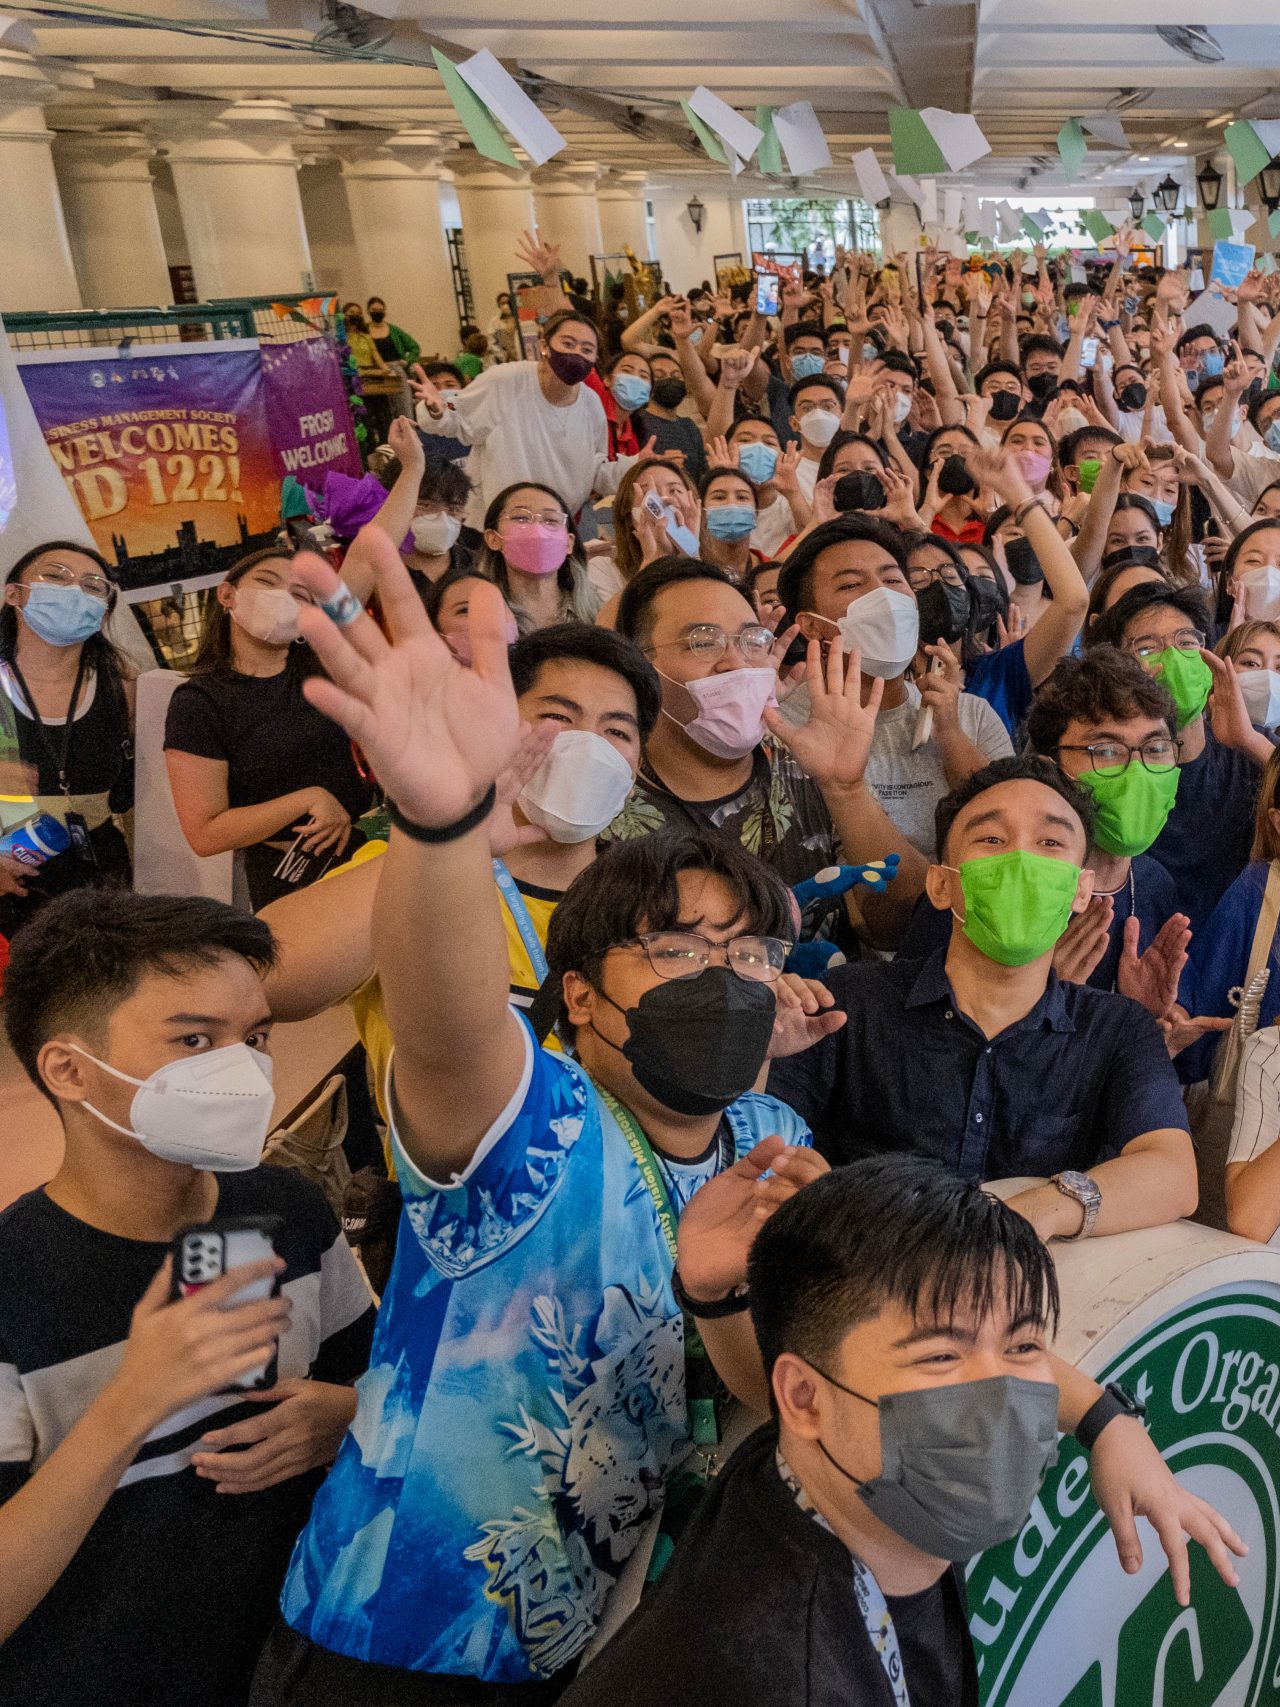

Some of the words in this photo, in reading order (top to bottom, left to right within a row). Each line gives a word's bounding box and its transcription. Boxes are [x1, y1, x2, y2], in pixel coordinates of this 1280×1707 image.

[47, 418, 99, 441] SINESS
[102, 409, 187, 426] MANAGEMENT
[190, 410, 237, 425] SOCIETY
[299, 409, 334, 439] FROSH
[138, 454, 243, 505] 122!
[13, 846, 40, 867] CLOR
[615, 1111, 648, 1165] Mission
[643, 1165, 664, 1210] Vision
[660, 1212, 679, 1262] versity
